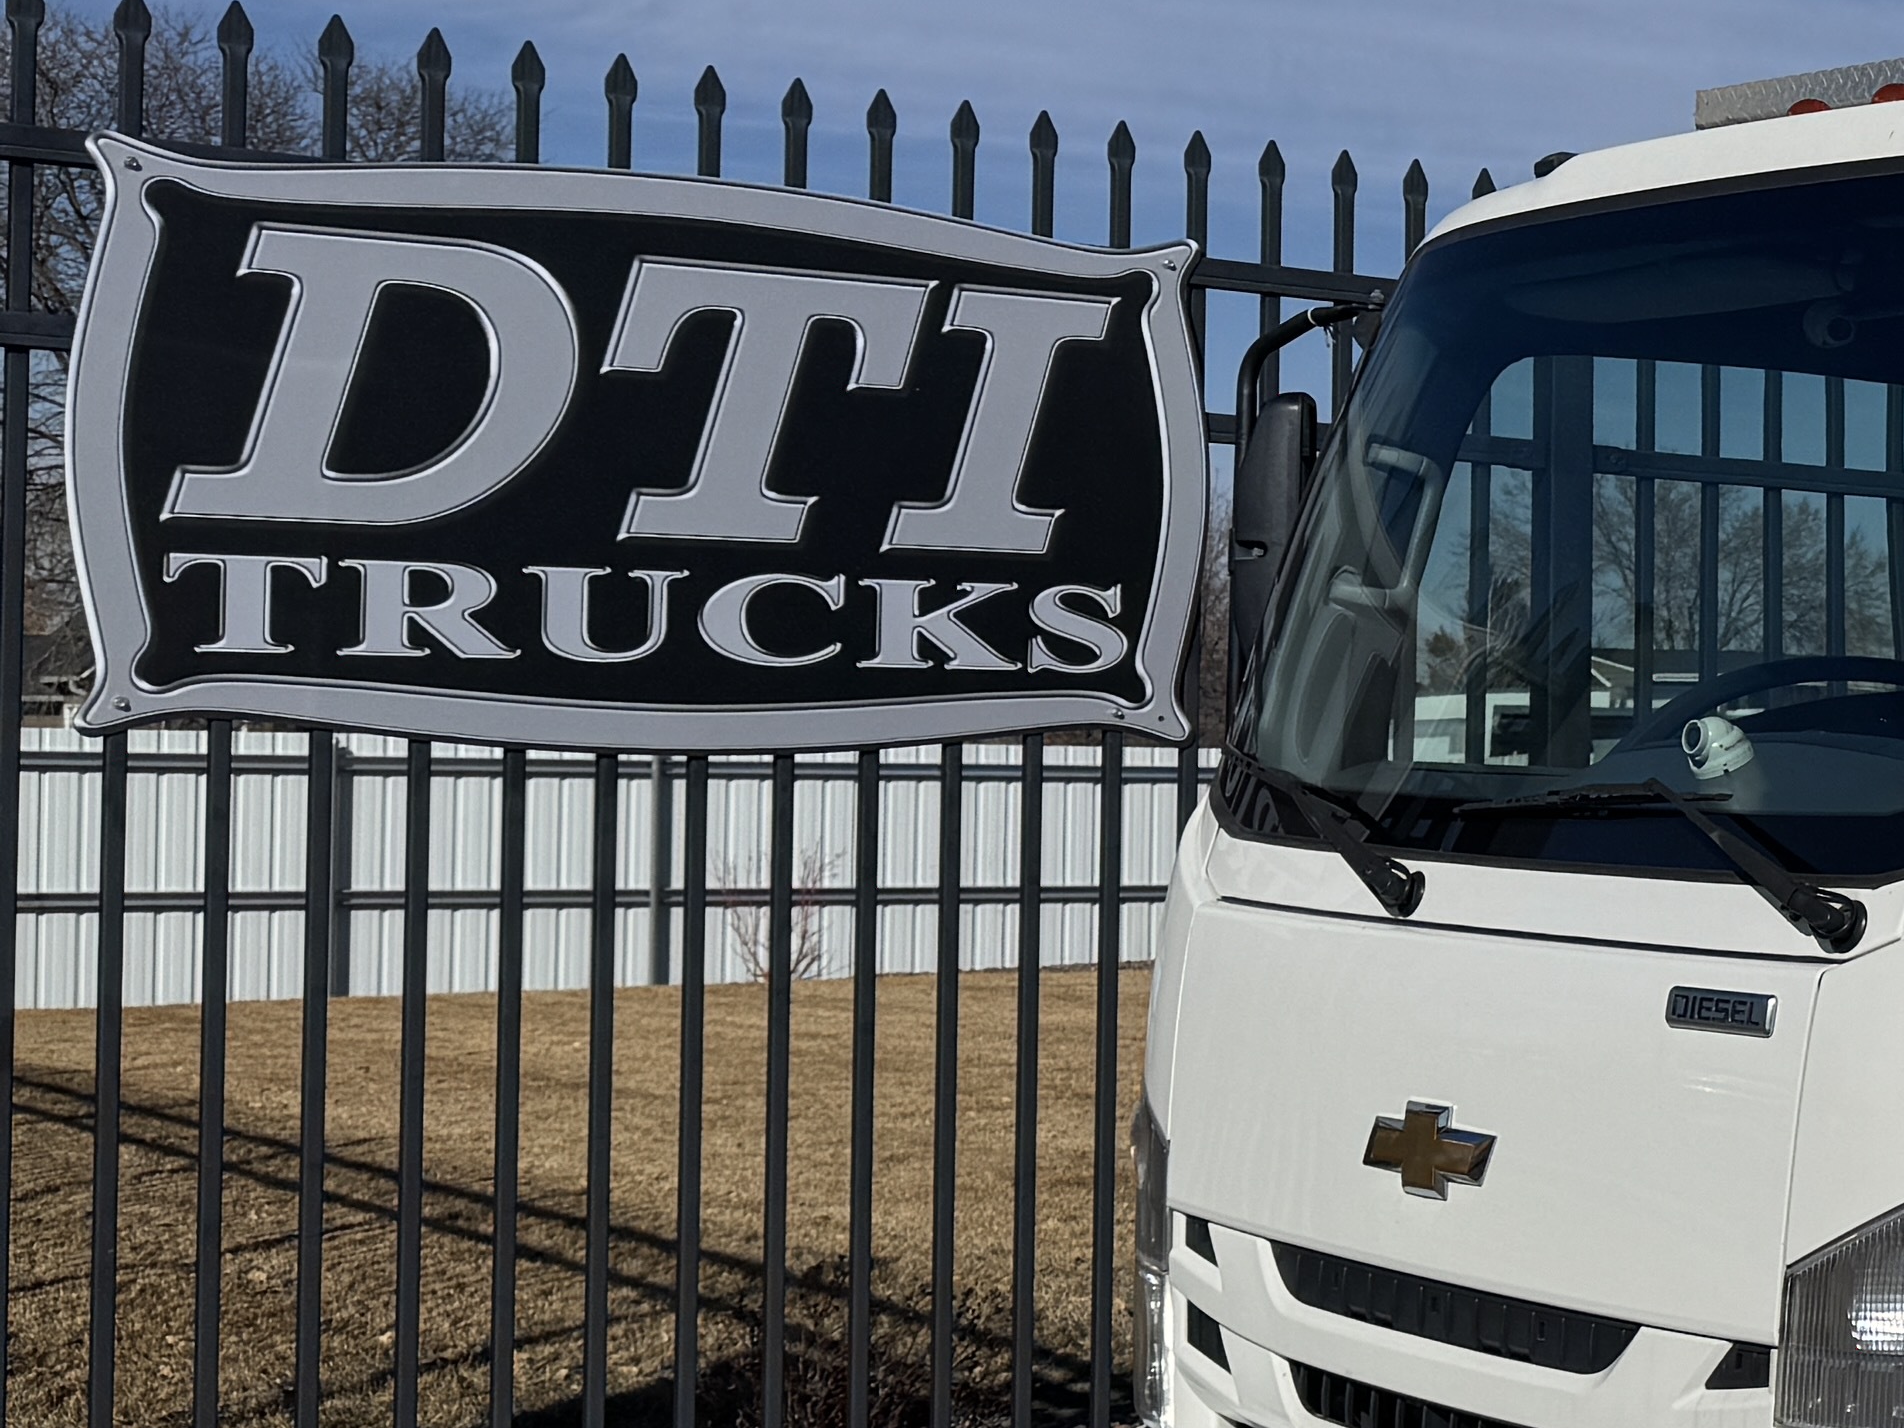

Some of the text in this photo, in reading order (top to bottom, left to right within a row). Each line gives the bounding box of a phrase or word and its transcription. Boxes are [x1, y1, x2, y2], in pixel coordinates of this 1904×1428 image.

[159, 221, 1122, 554] DTI
[162, 552, 1129, 675] TRUCKS
[1671, 993, 1760, 1027] DIESEL
